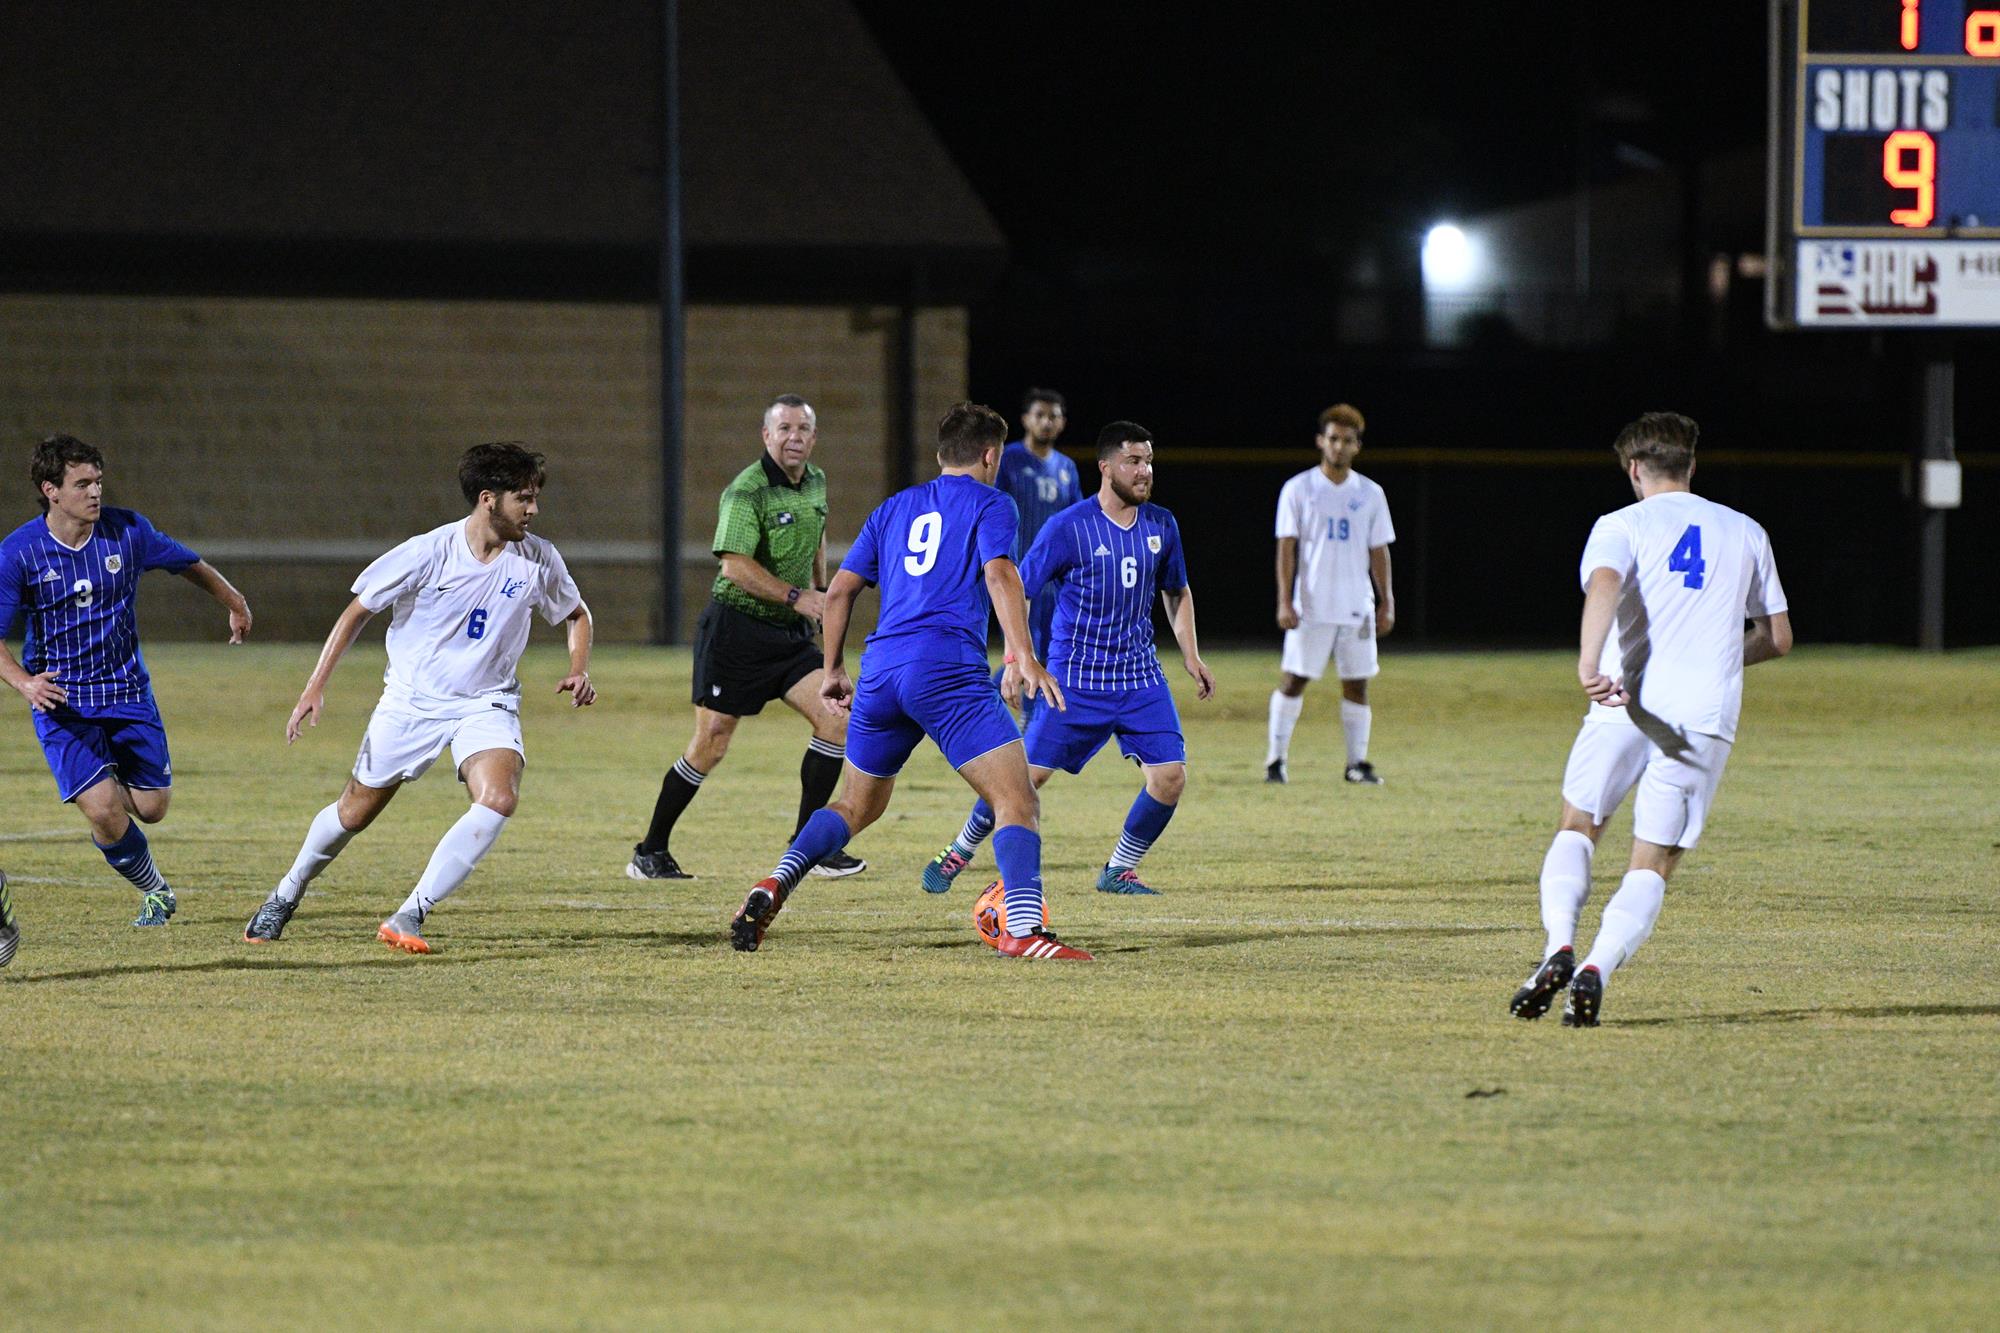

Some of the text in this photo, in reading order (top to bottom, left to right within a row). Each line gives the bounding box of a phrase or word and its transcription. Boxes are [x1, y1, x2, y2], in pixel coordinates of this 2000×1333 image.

[1815, 69, 1948, 131] SHOTS
[1884, 130, 1935, 228] 9
[904, 511, 942, 576] 9
[1327, 517, 1350, 540] 19
[1121, 556, 1137, 588] 6
[1668, 523, 1705, 590] 4
[74, 579, 93, 608] 3
[467, 608, 488, 639] 6
